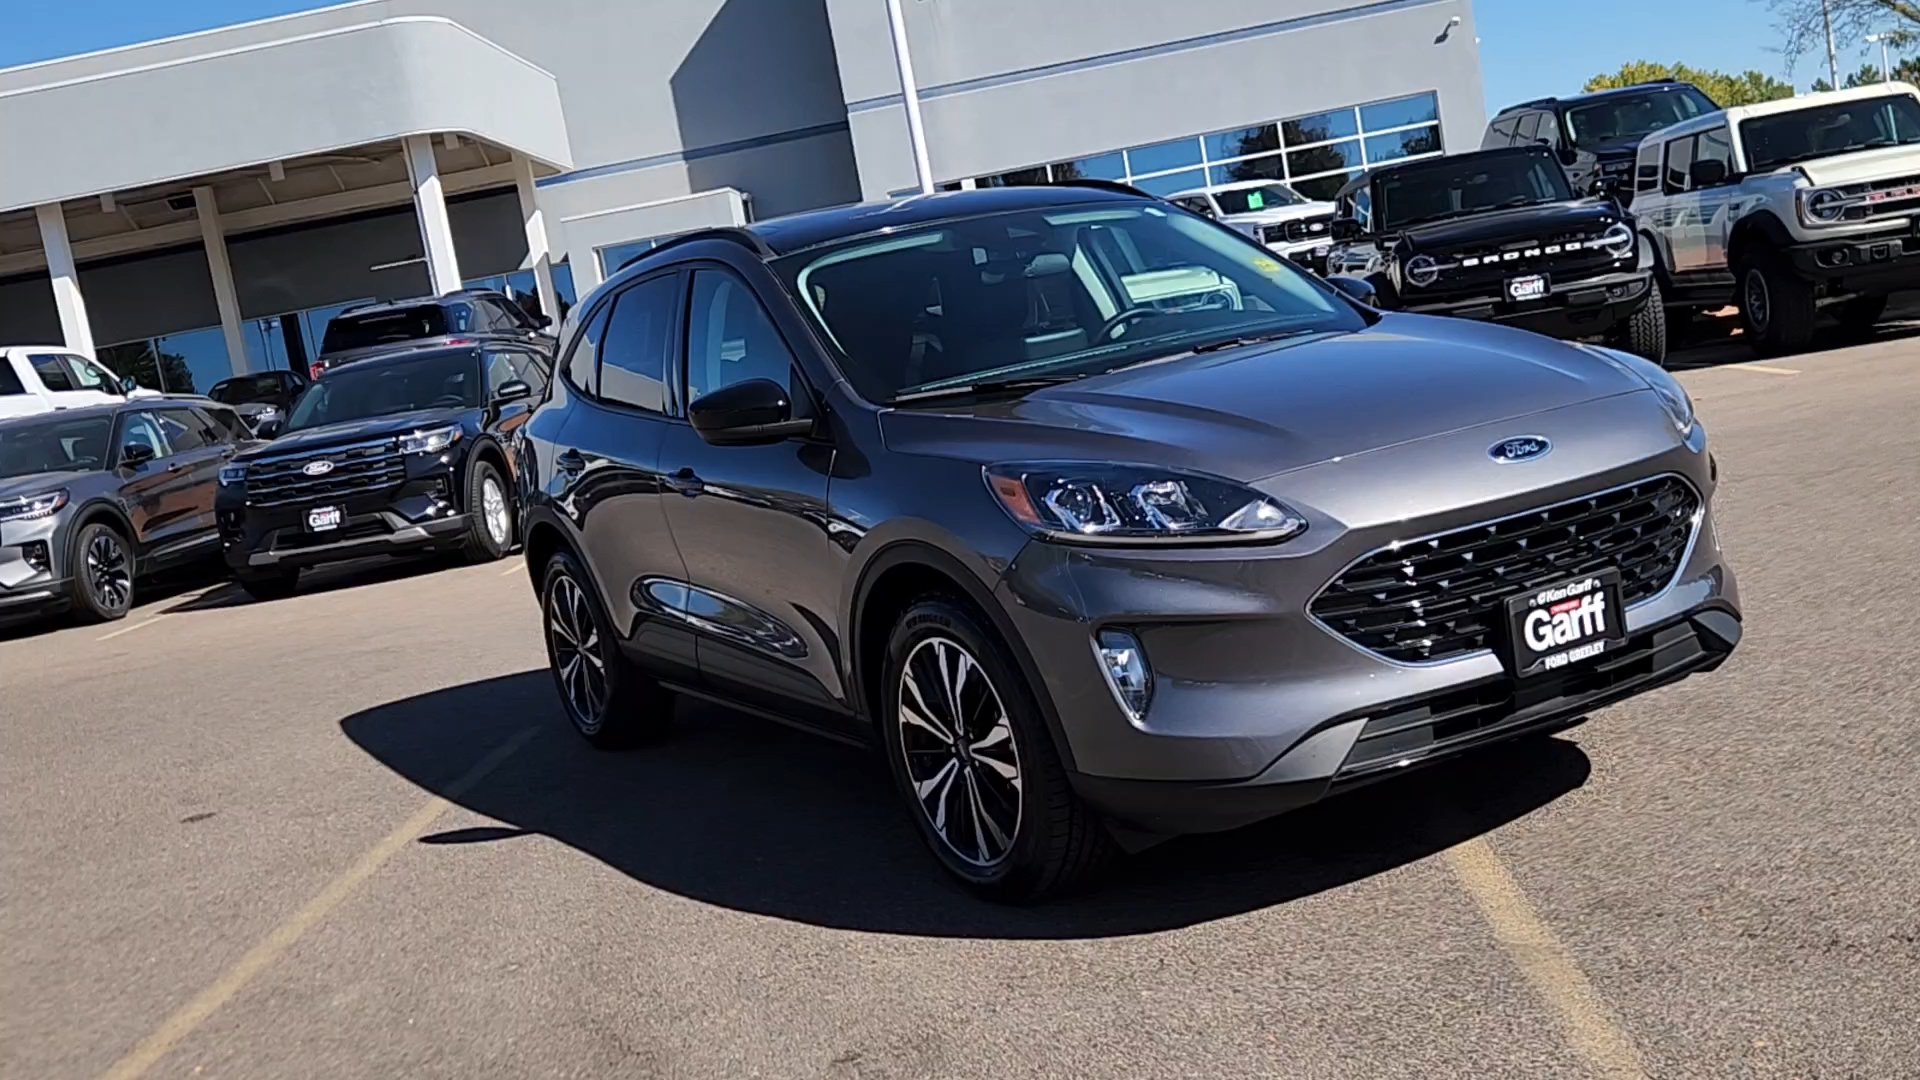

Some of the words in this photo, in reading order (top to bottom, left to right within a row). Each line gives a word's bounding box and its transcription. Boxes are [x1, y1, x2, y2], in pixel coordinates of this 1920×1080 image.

[1462, 242, 1582, 267] BRONCO
[1510, 279, 1545, 297] Garff
[1504, 440, 1539, 457] Ford
[309, 510, 341, 529] Garff
[1547, 588, 1567, 602] Ken
[1566, 578, 1593, 596] Garff
[1524, 591, 1606, 652] Garff
[1545, 653, 1569, 670] FORD
